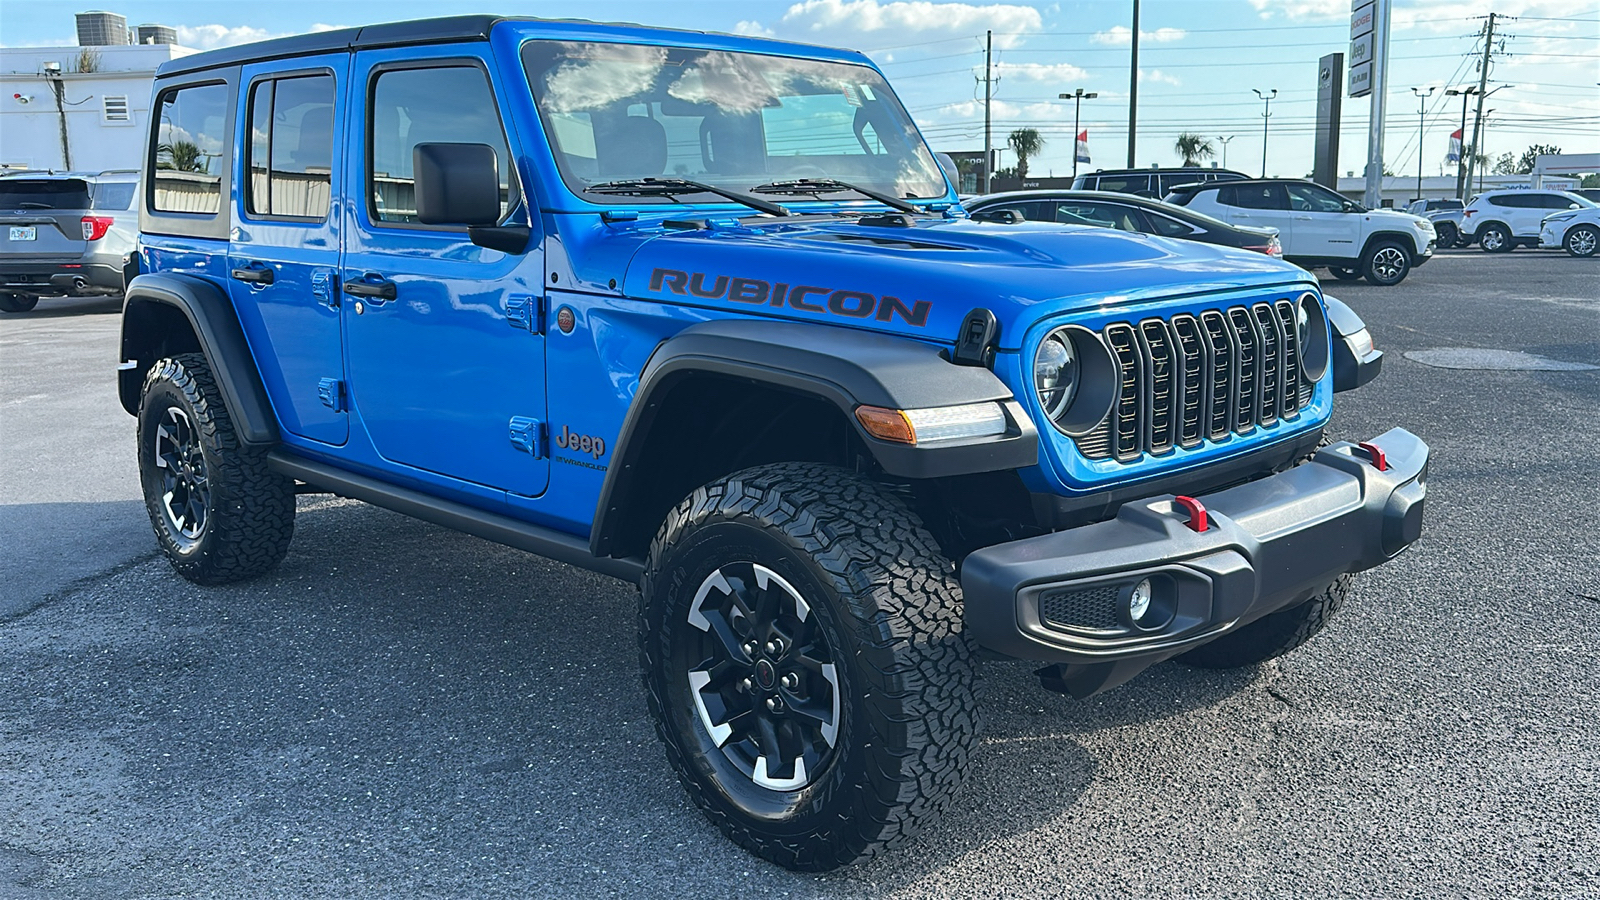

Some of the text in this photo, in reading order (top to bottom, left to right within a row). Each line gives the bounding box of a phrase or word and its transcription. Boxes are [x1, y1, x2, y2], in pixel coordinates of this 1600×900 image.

[1351, 43, 1365, 59] Jeep
[649, 268, 933, 327] RUBICON
[556, 425, 605, 460] Jeep
[563, 457, 608, 472] WRANGLER
